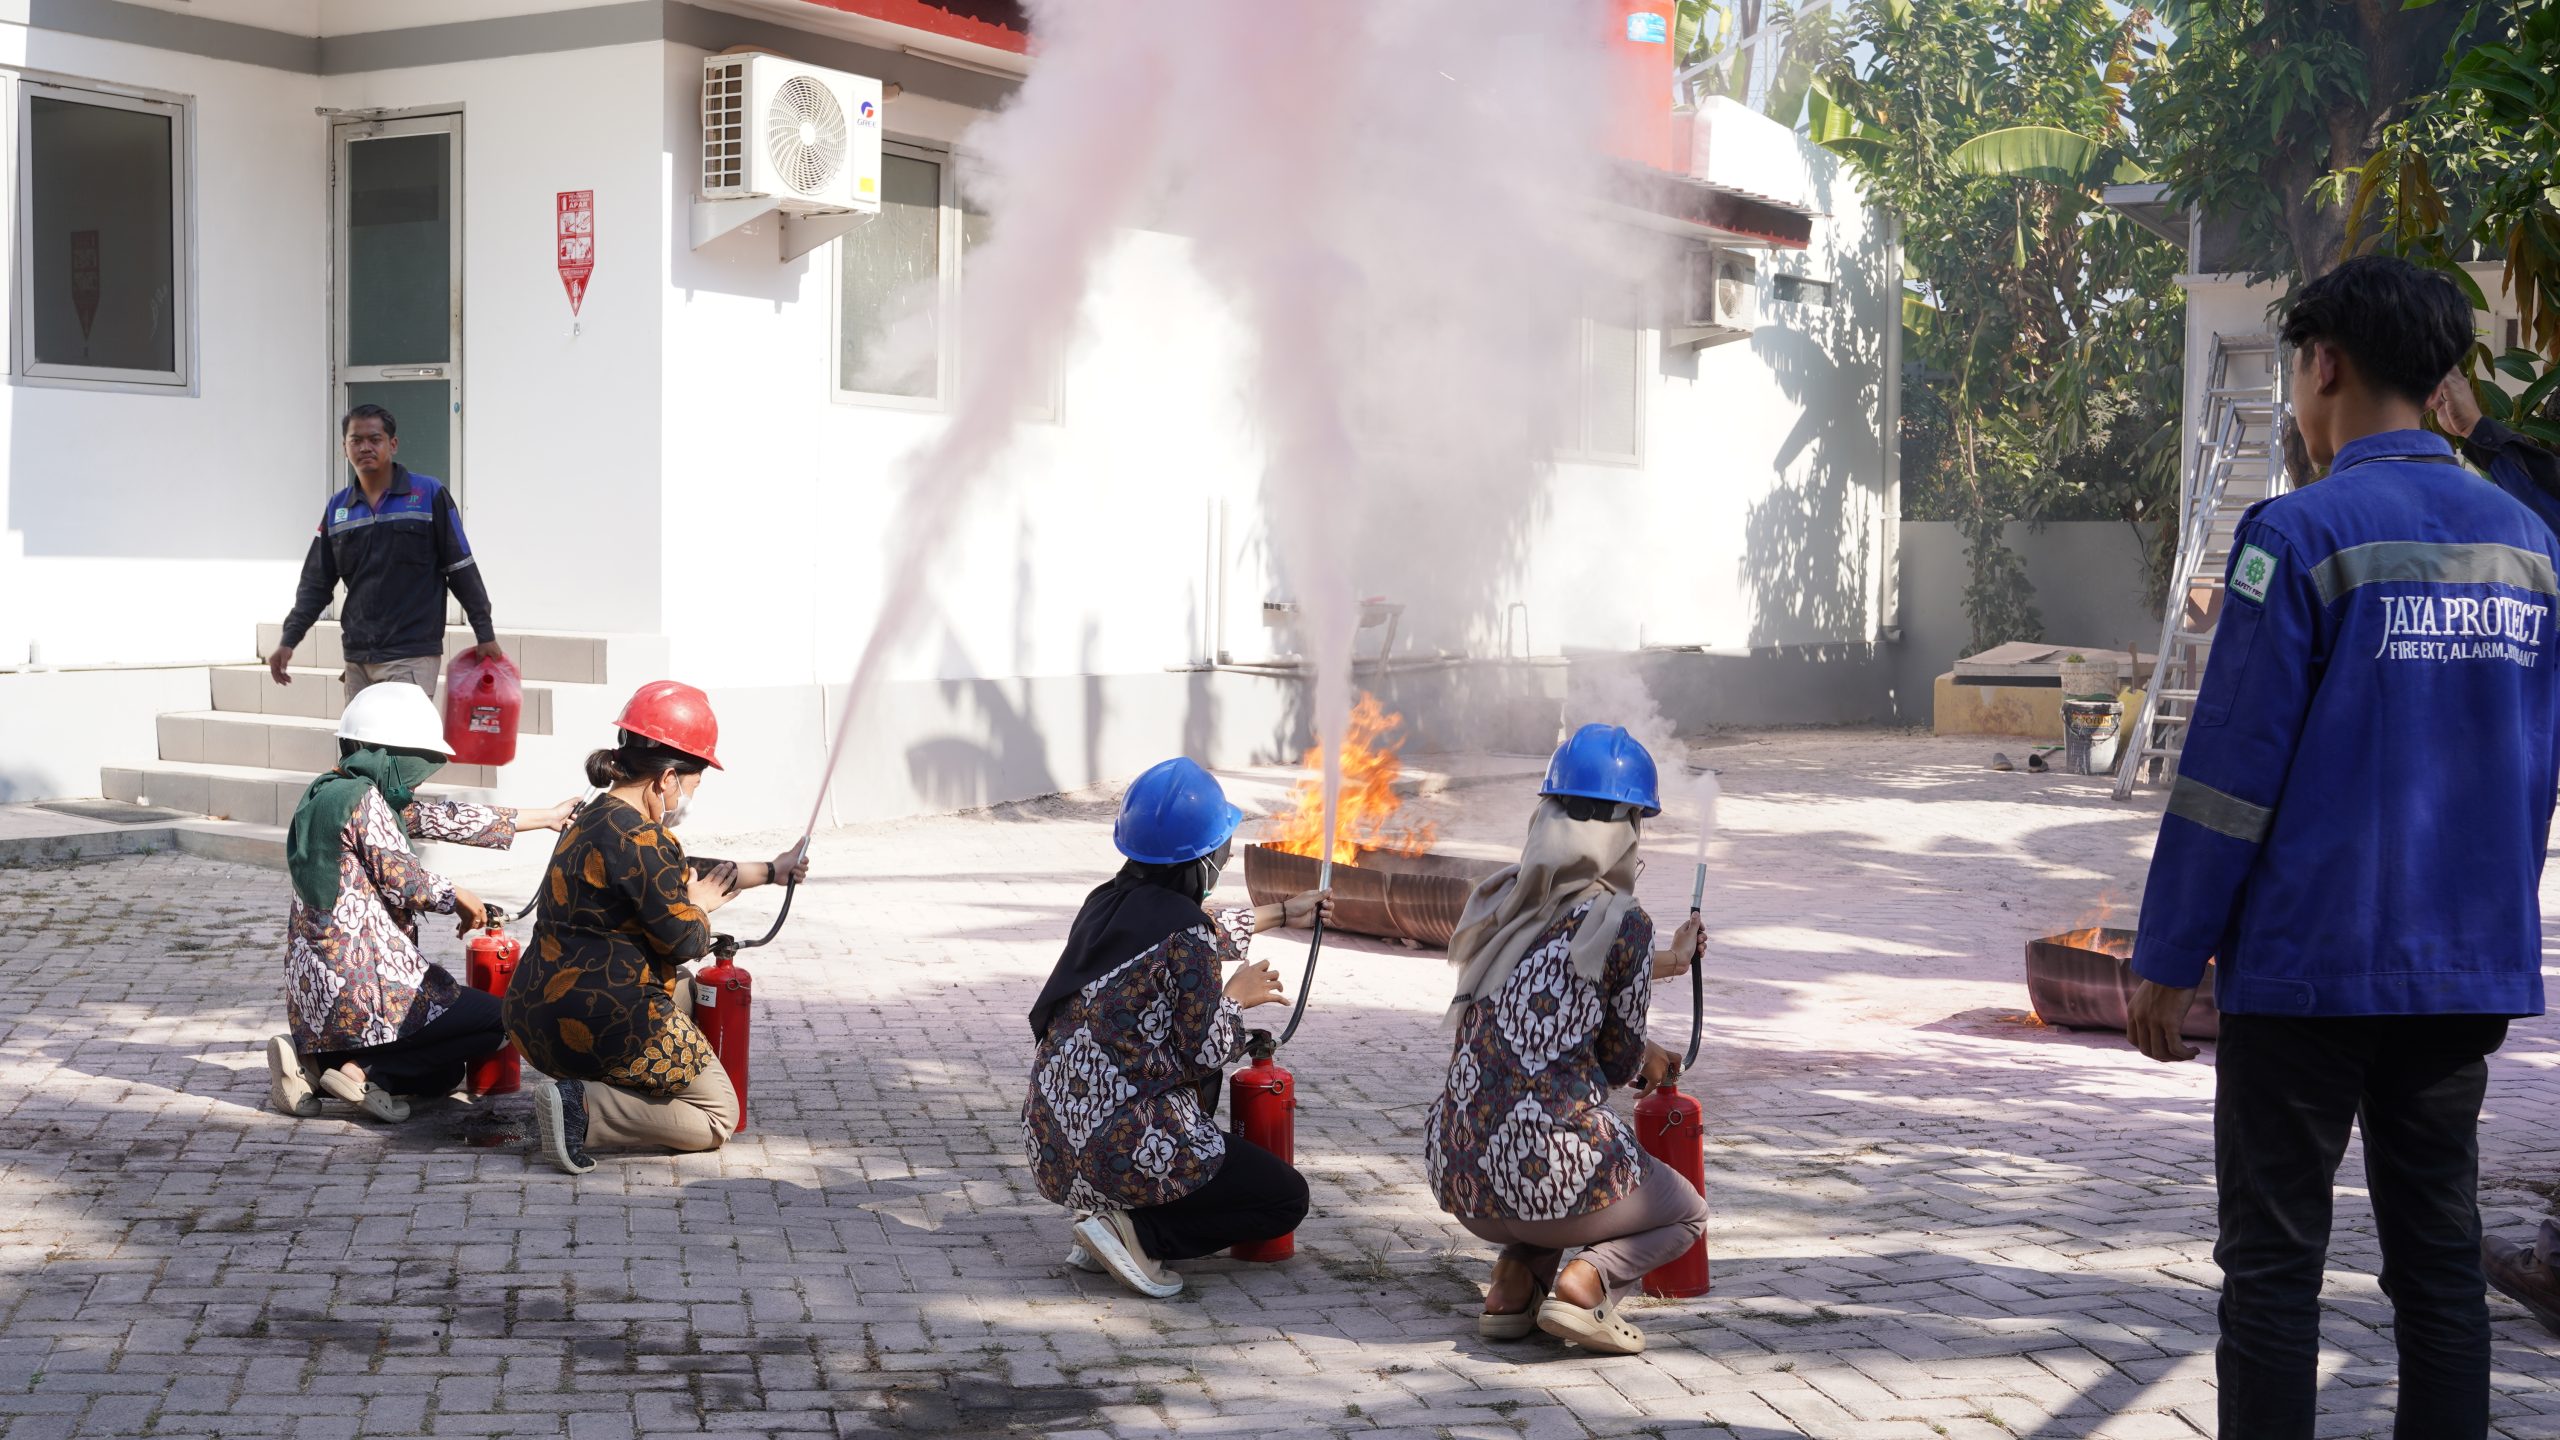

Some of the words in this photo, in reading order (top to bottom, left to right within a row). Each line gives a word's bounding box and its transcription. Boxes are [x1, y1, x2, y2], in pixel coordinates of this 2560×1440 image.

[2233, 579, 2253, 592] SAFETY
[2374, 595, 2442, 659] JAYA
[2440, 596, 2548, 646] PROTECT
[2389, 641, 2419, 660] FIRE
[2420, 642, 2448, 664] EXT,
[2449, 641, 2508, 661] ALARM,
[701, 994, 710, 1002] 22
